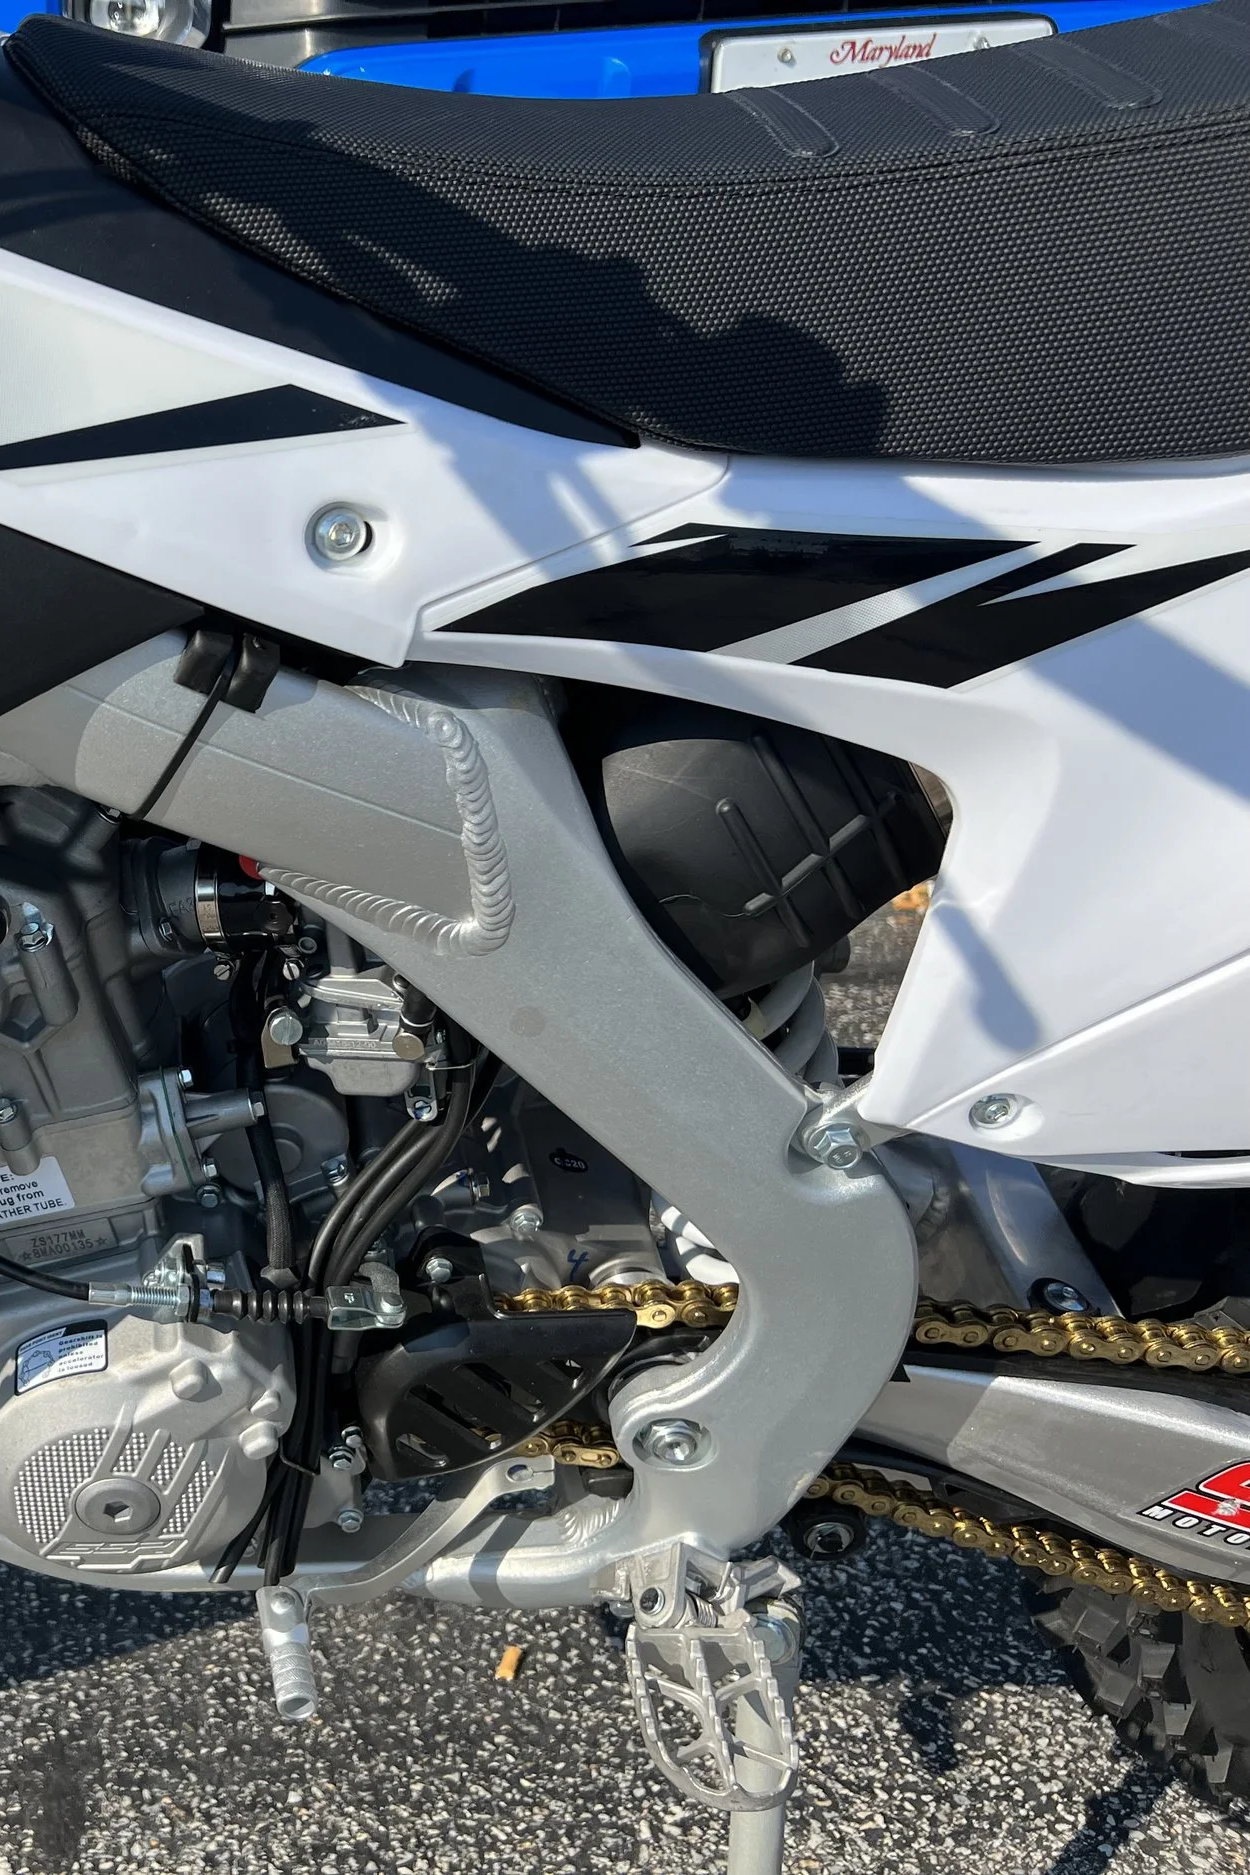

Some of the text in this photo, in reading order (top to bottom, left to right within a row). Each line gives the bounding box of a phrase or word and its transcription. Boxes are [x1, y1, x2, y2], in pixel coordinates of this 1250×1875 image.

[830, 32, 937, 68] Maryland
[0, 1180, 38, 1195] remove
[16, 1189, 45, 1202] from
